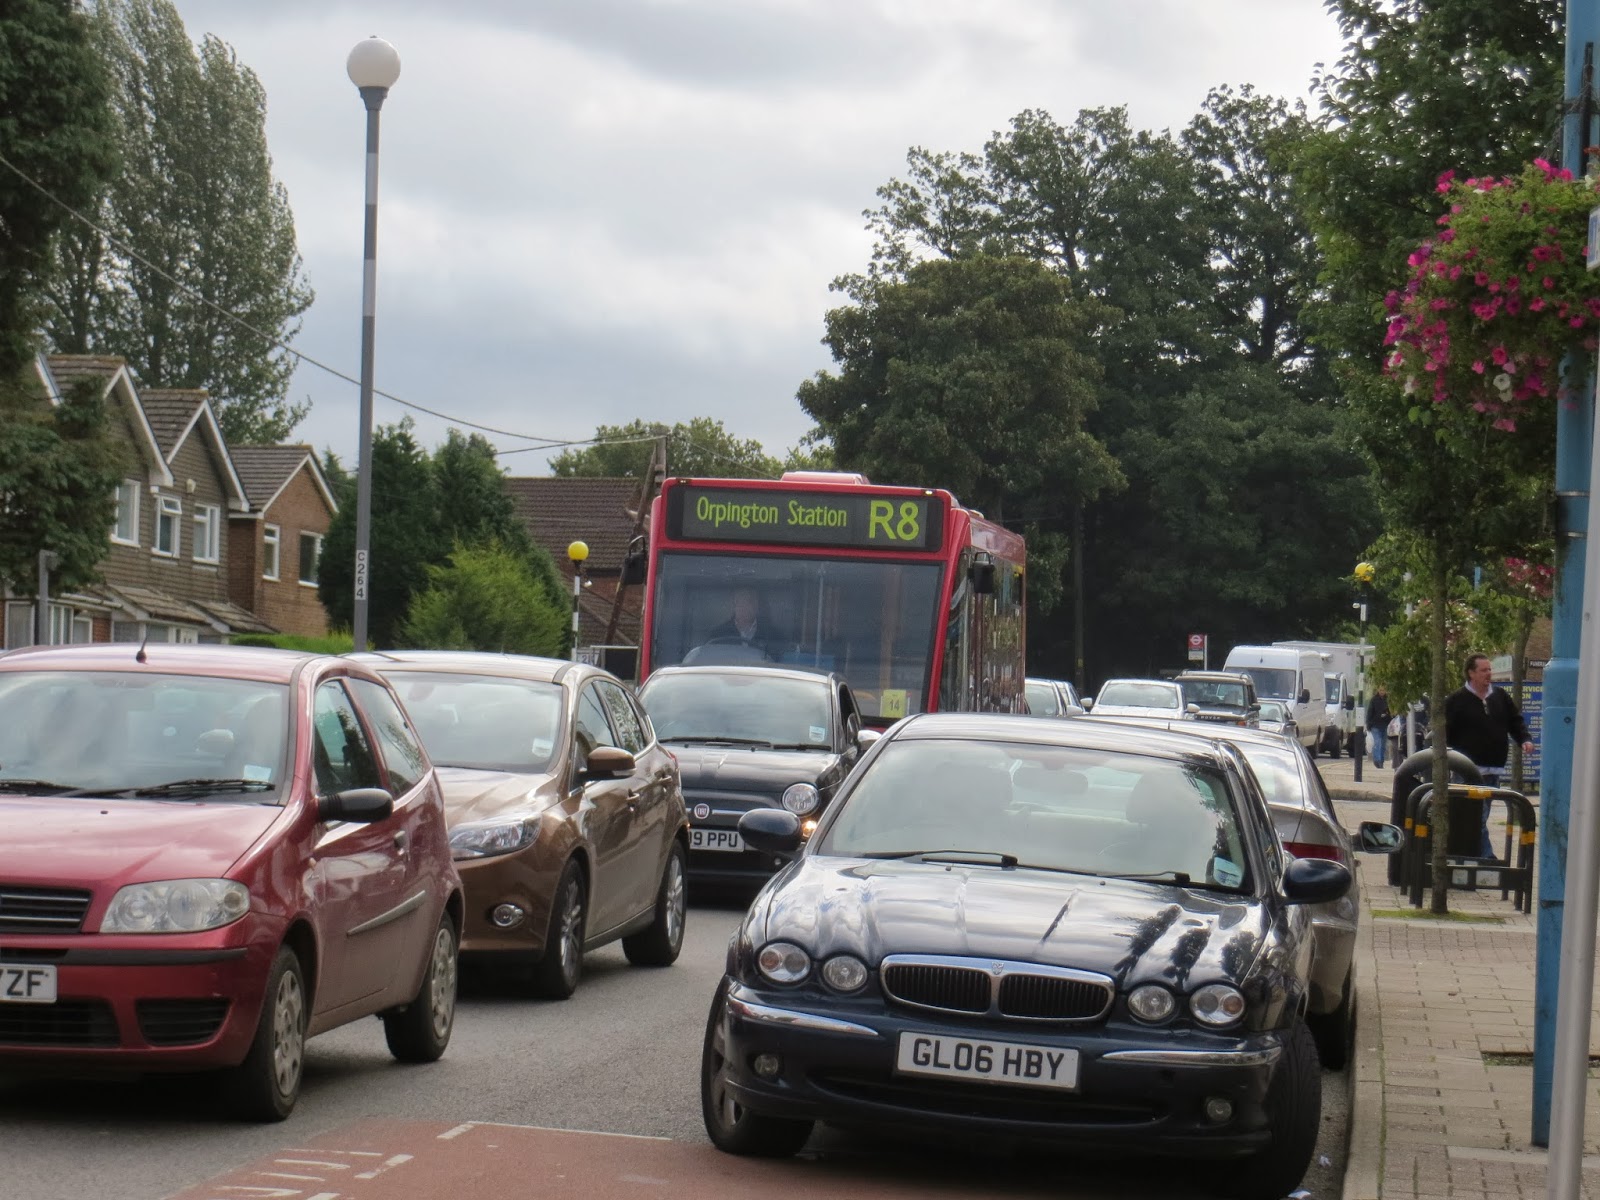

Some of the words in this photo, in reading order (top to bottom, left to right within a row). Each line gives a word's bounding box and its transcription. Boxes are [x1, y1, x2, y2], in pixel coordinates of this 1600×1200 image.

[697, 497, 778, 528] Orpington
[787, 500, 847, 527] Station
[869, 500, 919, 540] R8
[889, 699, 900, 711] 14
[707, 832, 738, 848] PPU
[913, 1038, 994, 1073] GL06
[1002, 1047, 1065, 1080] HBY
